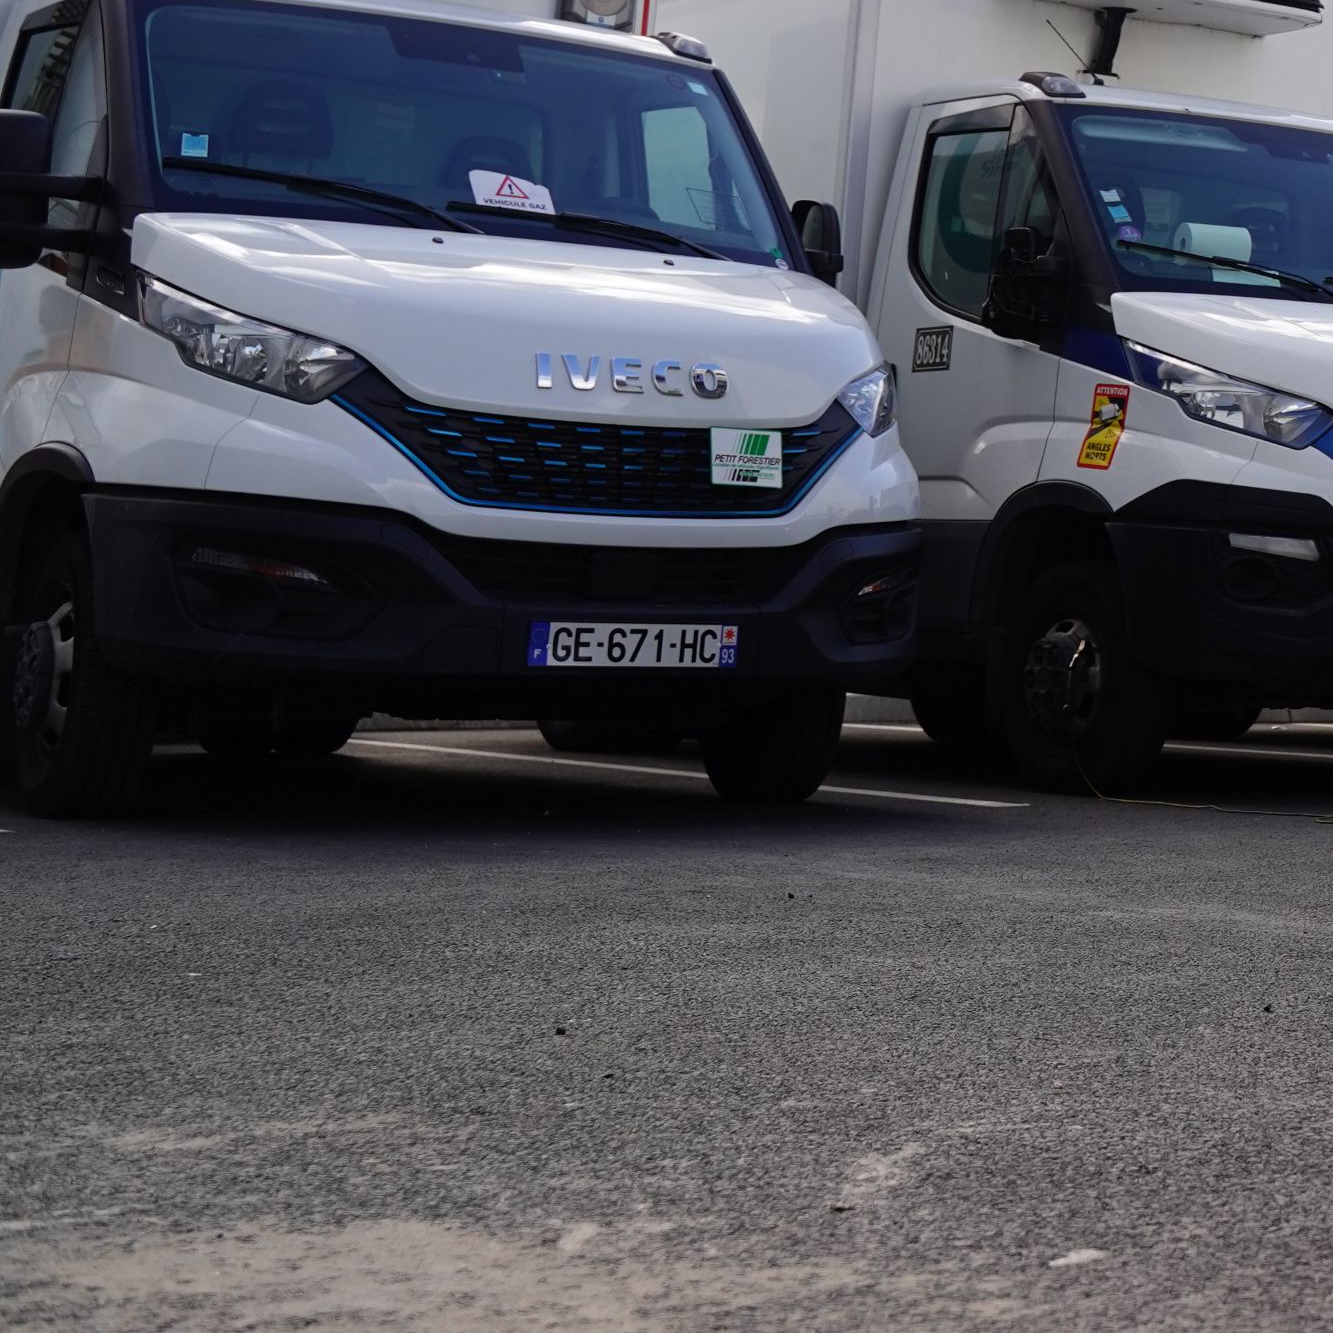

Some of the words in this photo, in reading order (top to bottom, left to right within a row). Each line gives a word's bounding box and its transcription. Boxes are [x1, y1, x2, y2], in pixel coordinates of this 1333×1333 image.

[529, 202, 547, 211] GAZ
[916, 335, 949, 364] 86314
[535, 352, 729, 399] IVECO
[1096, 386, 1128, 396] ATTENTION
[1086, 442, 1111, 453] ANGLES
[715, 454, 738, 463] PETIT
[738, 455, 781, 466] FORESTIER
[1085, 451, 1107, 461] MORTS
[534, 649, 541, 659] F
[552, 627, 718, 663] GE-671-HC
[721, 648, 735, 664] 93
